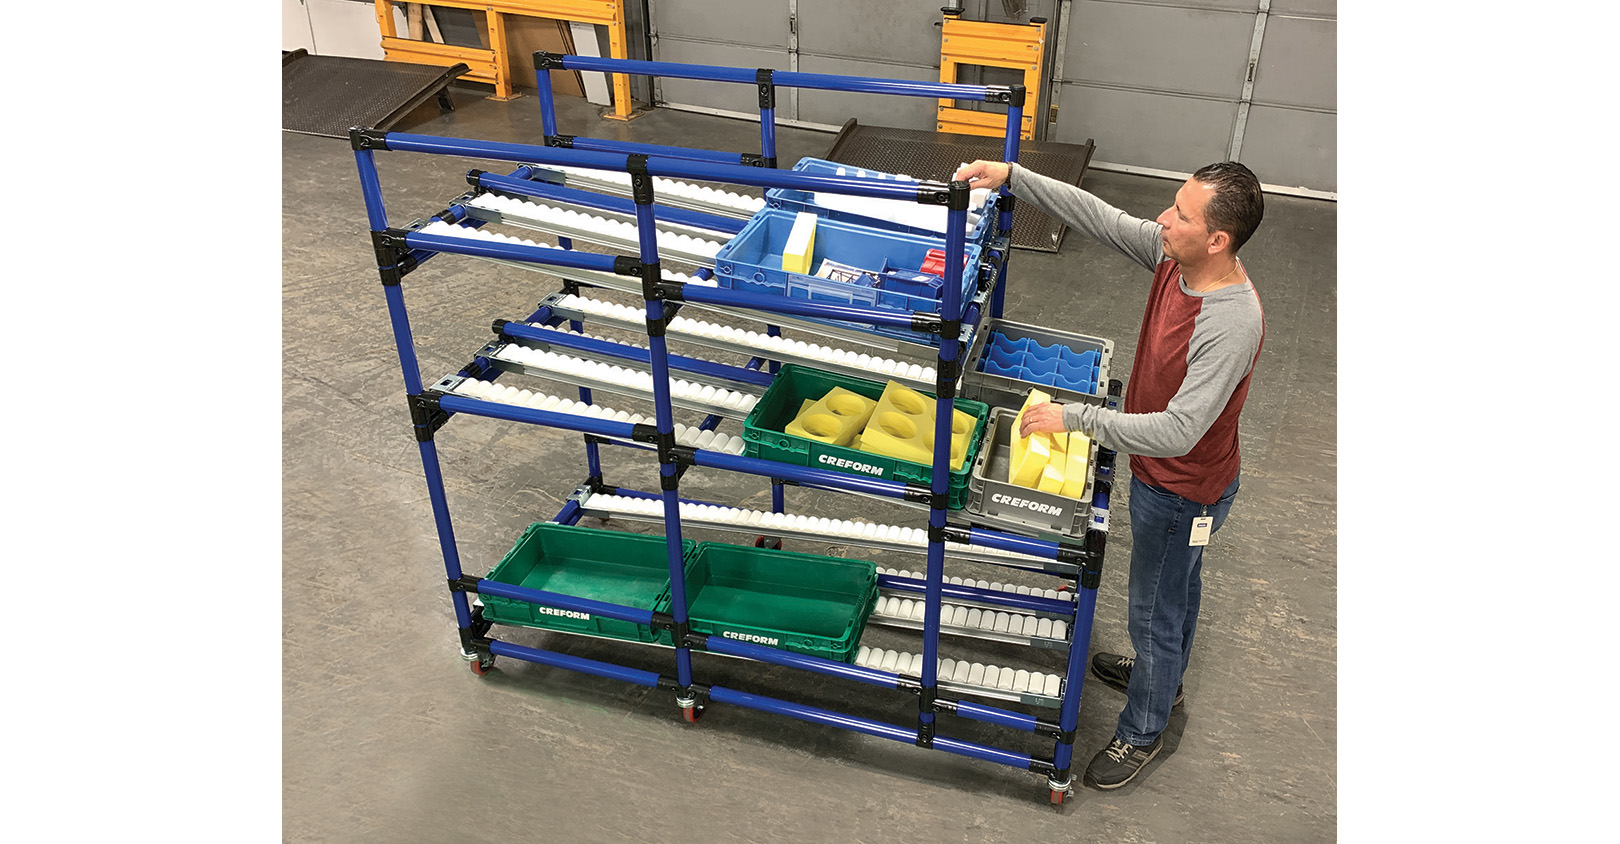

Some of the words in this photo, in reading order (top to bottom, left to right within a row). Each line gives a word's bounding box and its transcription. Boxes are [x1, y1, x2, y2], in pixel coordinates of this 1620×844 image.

[818, 454, 884, 476] CREFORM
[991, 493, 1063, 517] CREFORM
[539, 606, 590, 620] CREFORM
[723, 631, 779, 646] CREFORM
